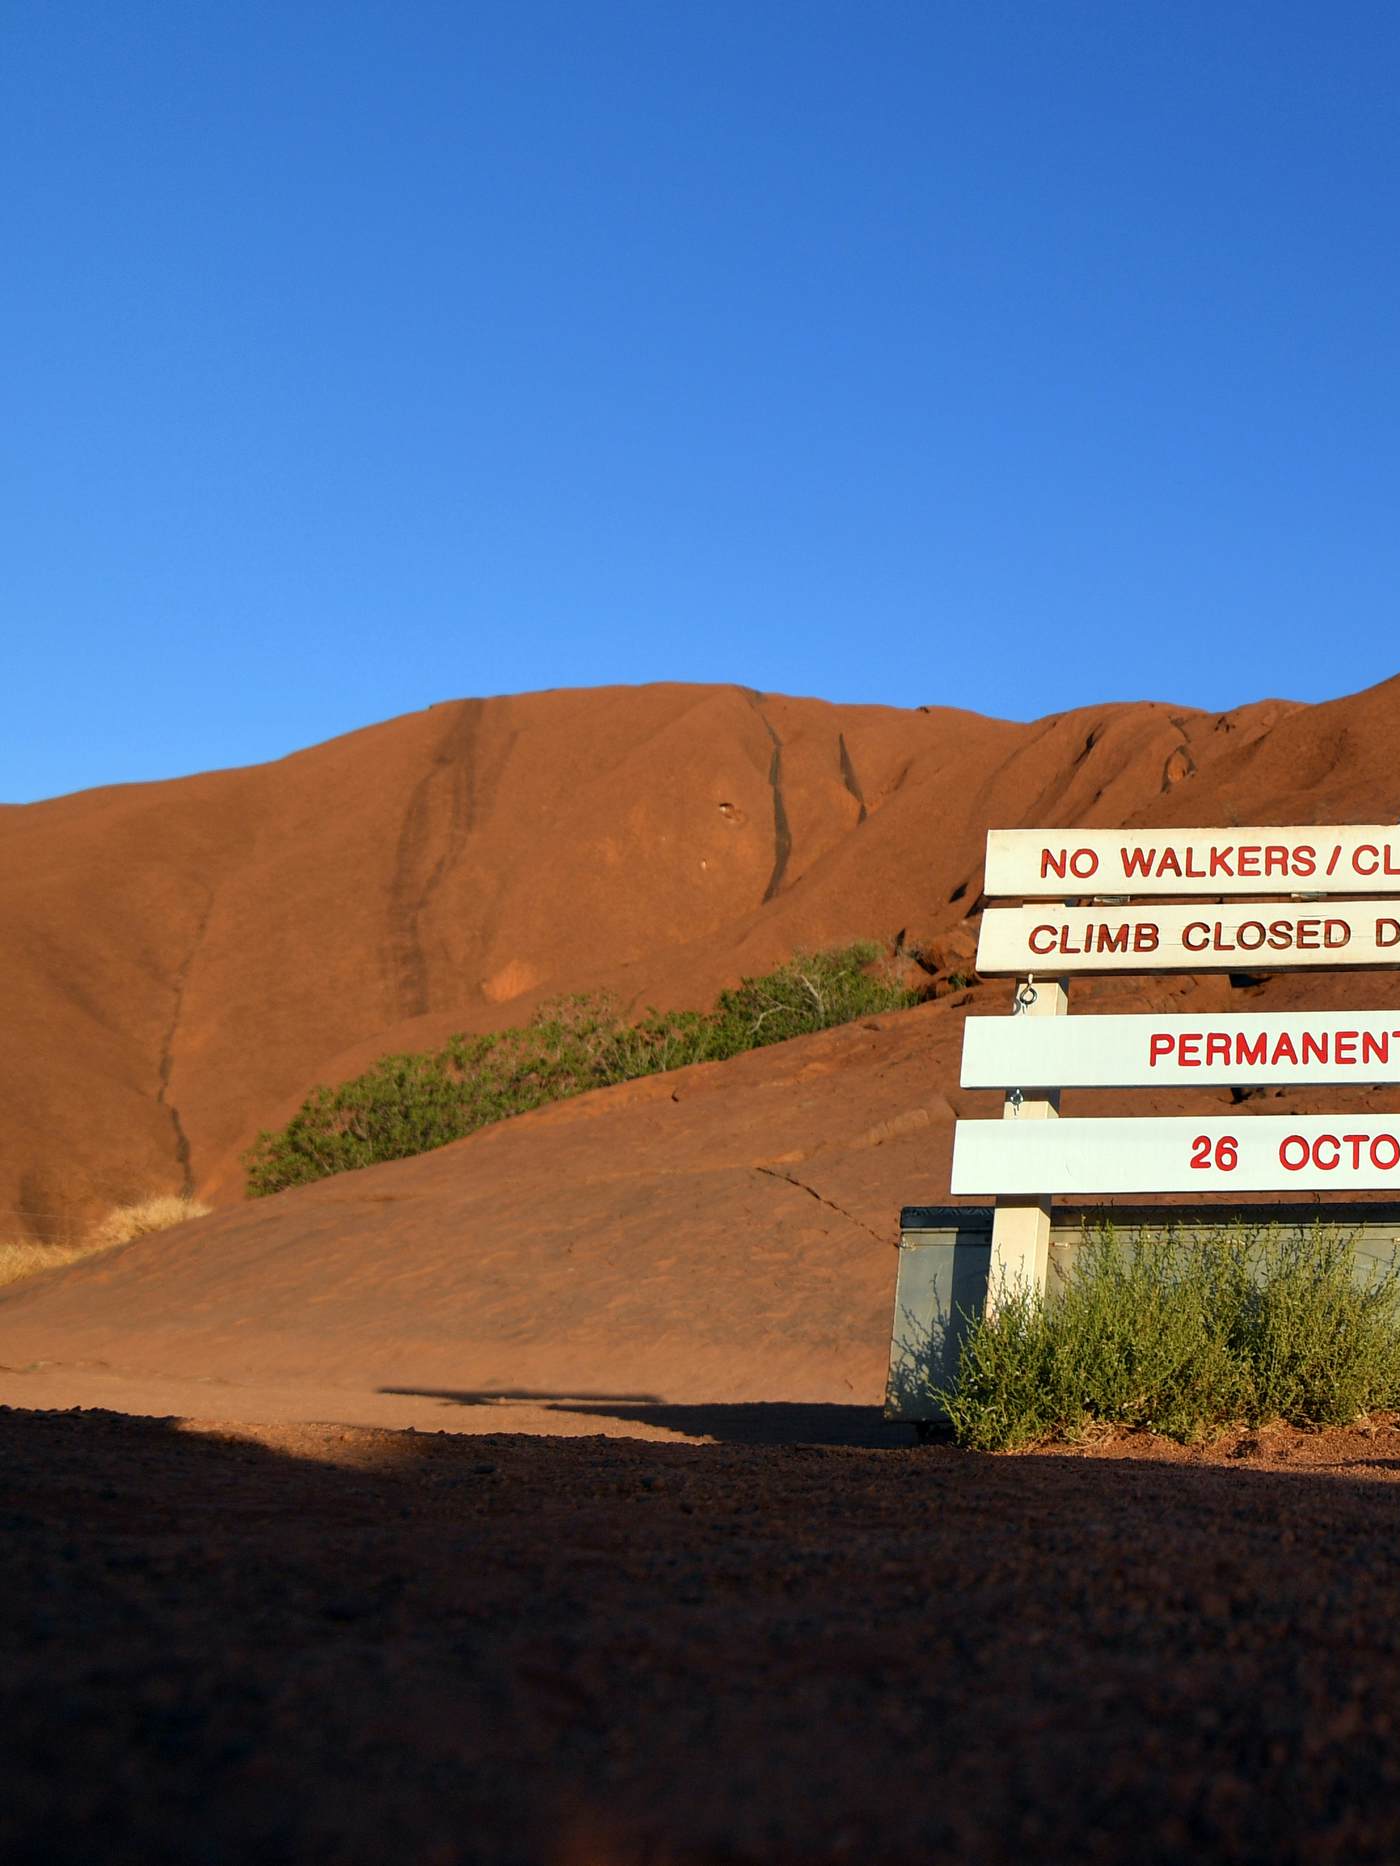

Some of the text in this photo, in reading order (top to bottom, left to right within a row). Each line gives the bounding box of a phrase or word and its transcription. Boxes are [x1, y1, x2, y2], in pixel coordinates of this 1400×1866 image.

[1040, 848, 1099, 879] NO
[1028, 923, 1160, 955] CLIMB
[1181, 919, 1351, 951] CLOSED
[1189, 1135, 1239, 1172] 26
